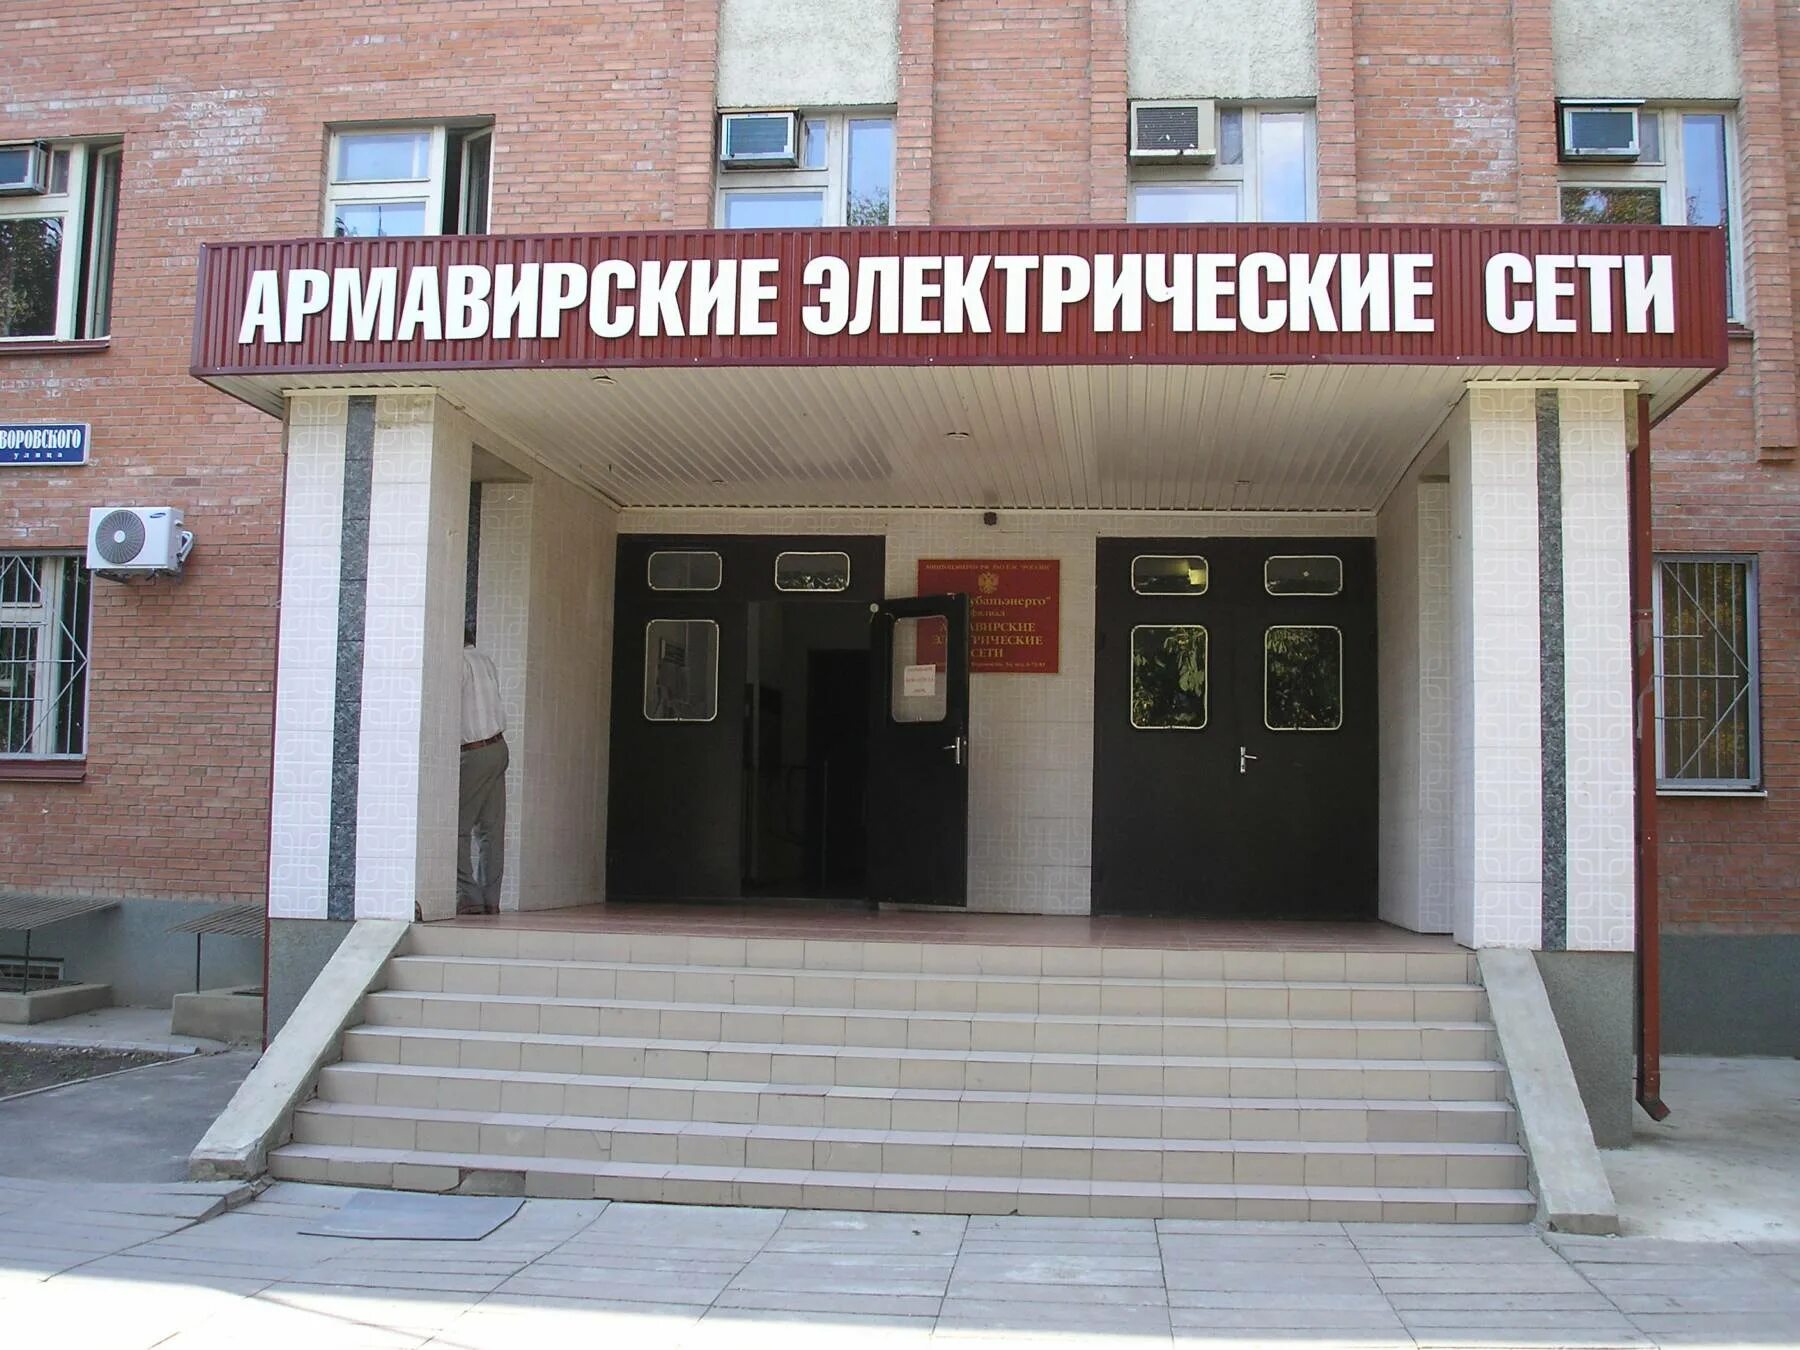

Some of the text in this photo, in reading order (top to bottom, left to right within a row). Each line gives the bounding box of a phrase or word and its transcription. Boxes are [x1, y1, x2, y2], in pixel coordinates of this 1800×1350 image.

[238, 252, 1675, 345] АРМАВИРСКИЕ ЭЛЕКТРИЧЕСКИЕ СЕТИ
[0, 428, 82, 449] ВОРОВСКОГО
[13, 452, 63, 460] улица
[970, 647, 1004, 658] СЕТИ
